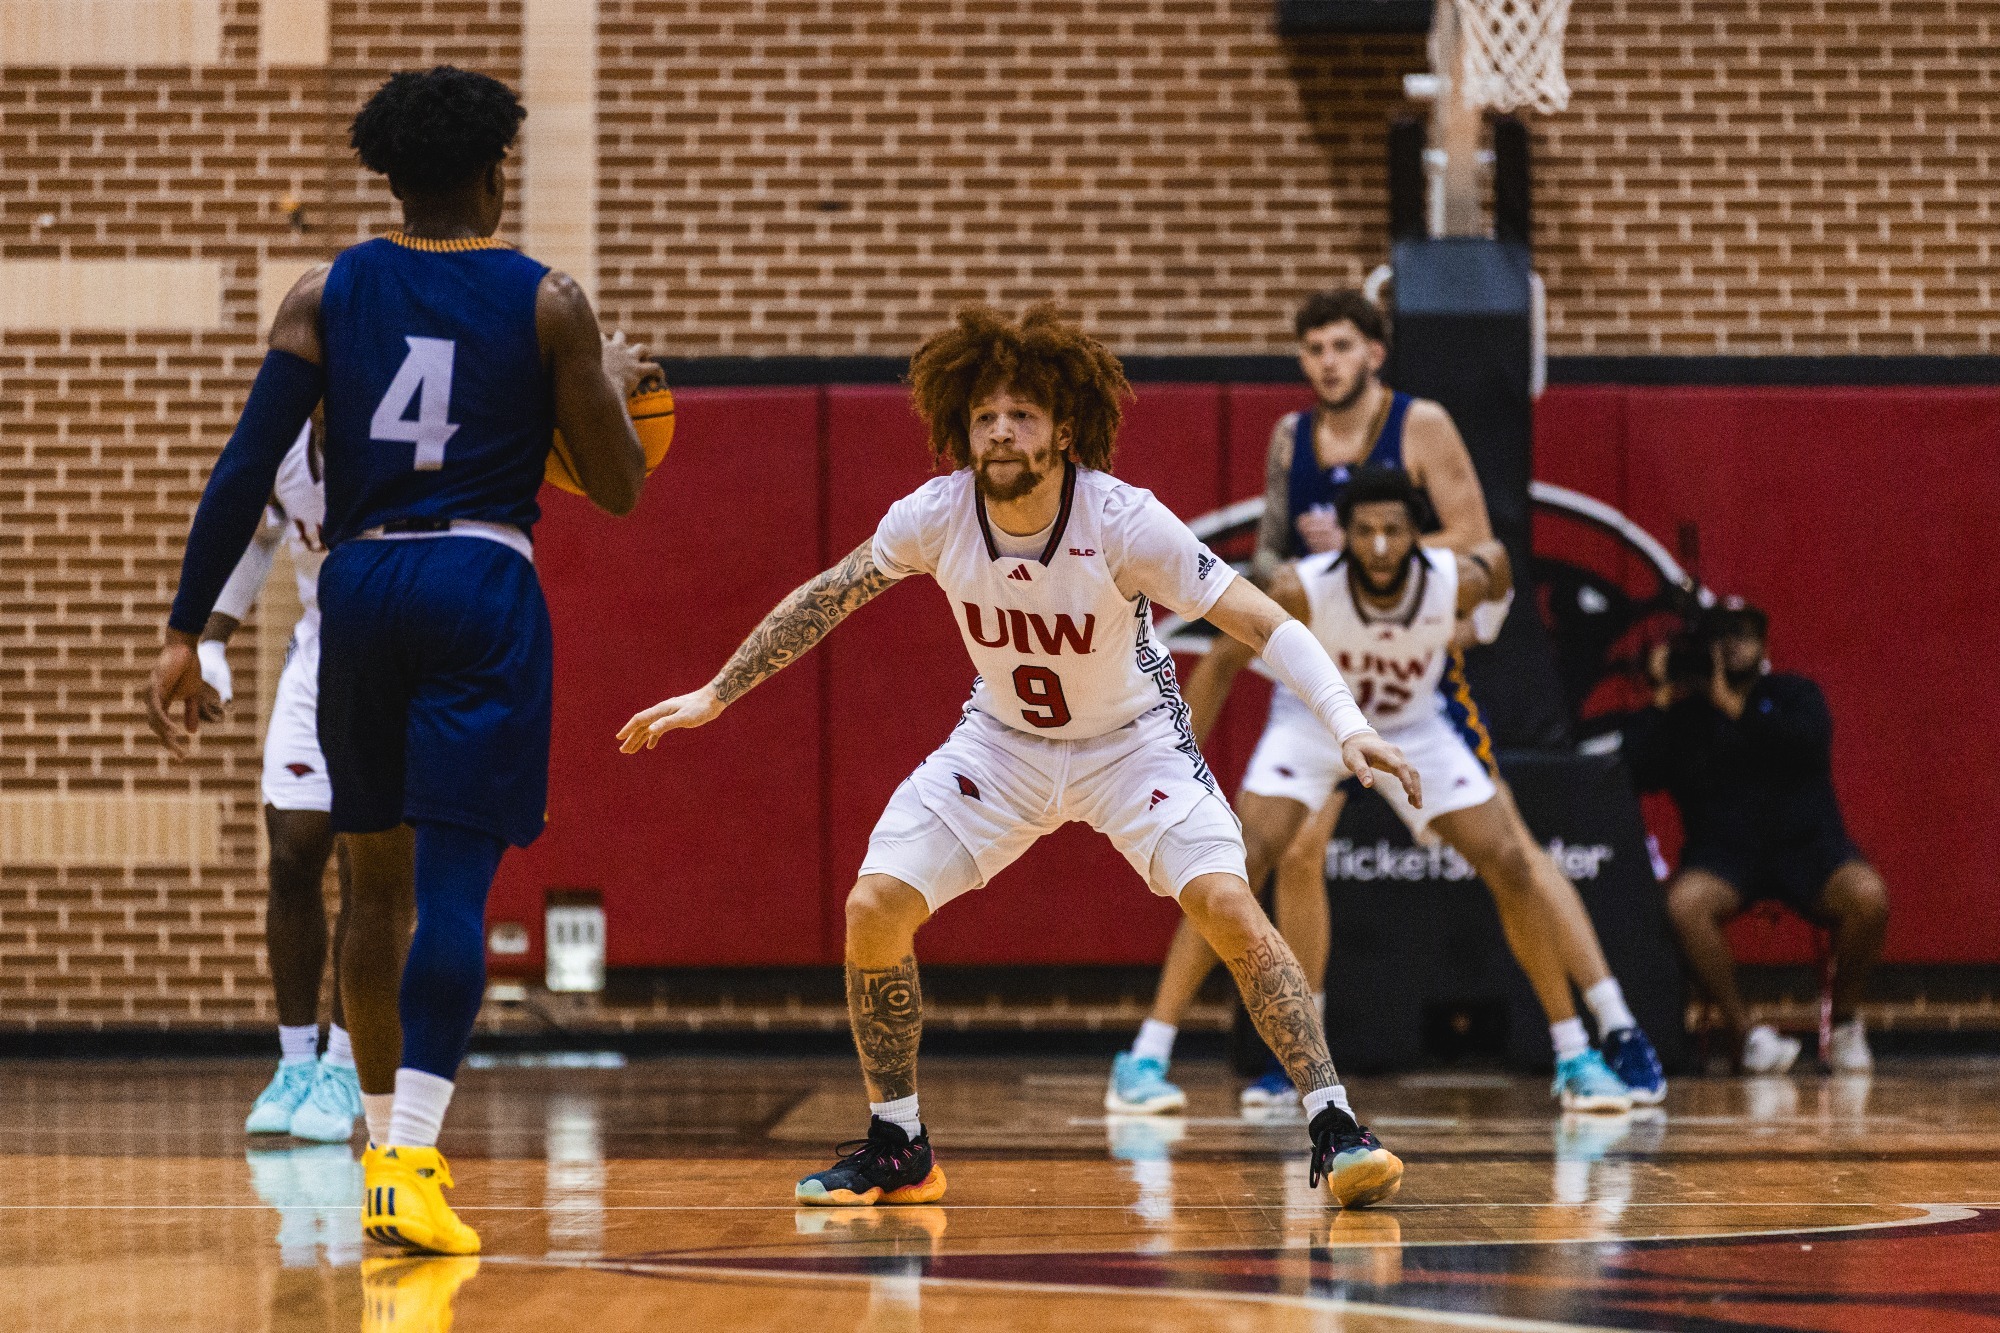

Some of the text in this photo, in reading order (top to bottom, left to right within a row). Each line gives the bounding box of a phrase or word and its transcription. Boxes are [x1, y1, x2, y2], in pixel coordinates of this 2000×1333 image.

[369, 335, 461, 471] 4
[1068, 548, 1096, 557] SLC
[960, 600, 1096, 656] UIW
[1011, 664, 1072, 729] 9
